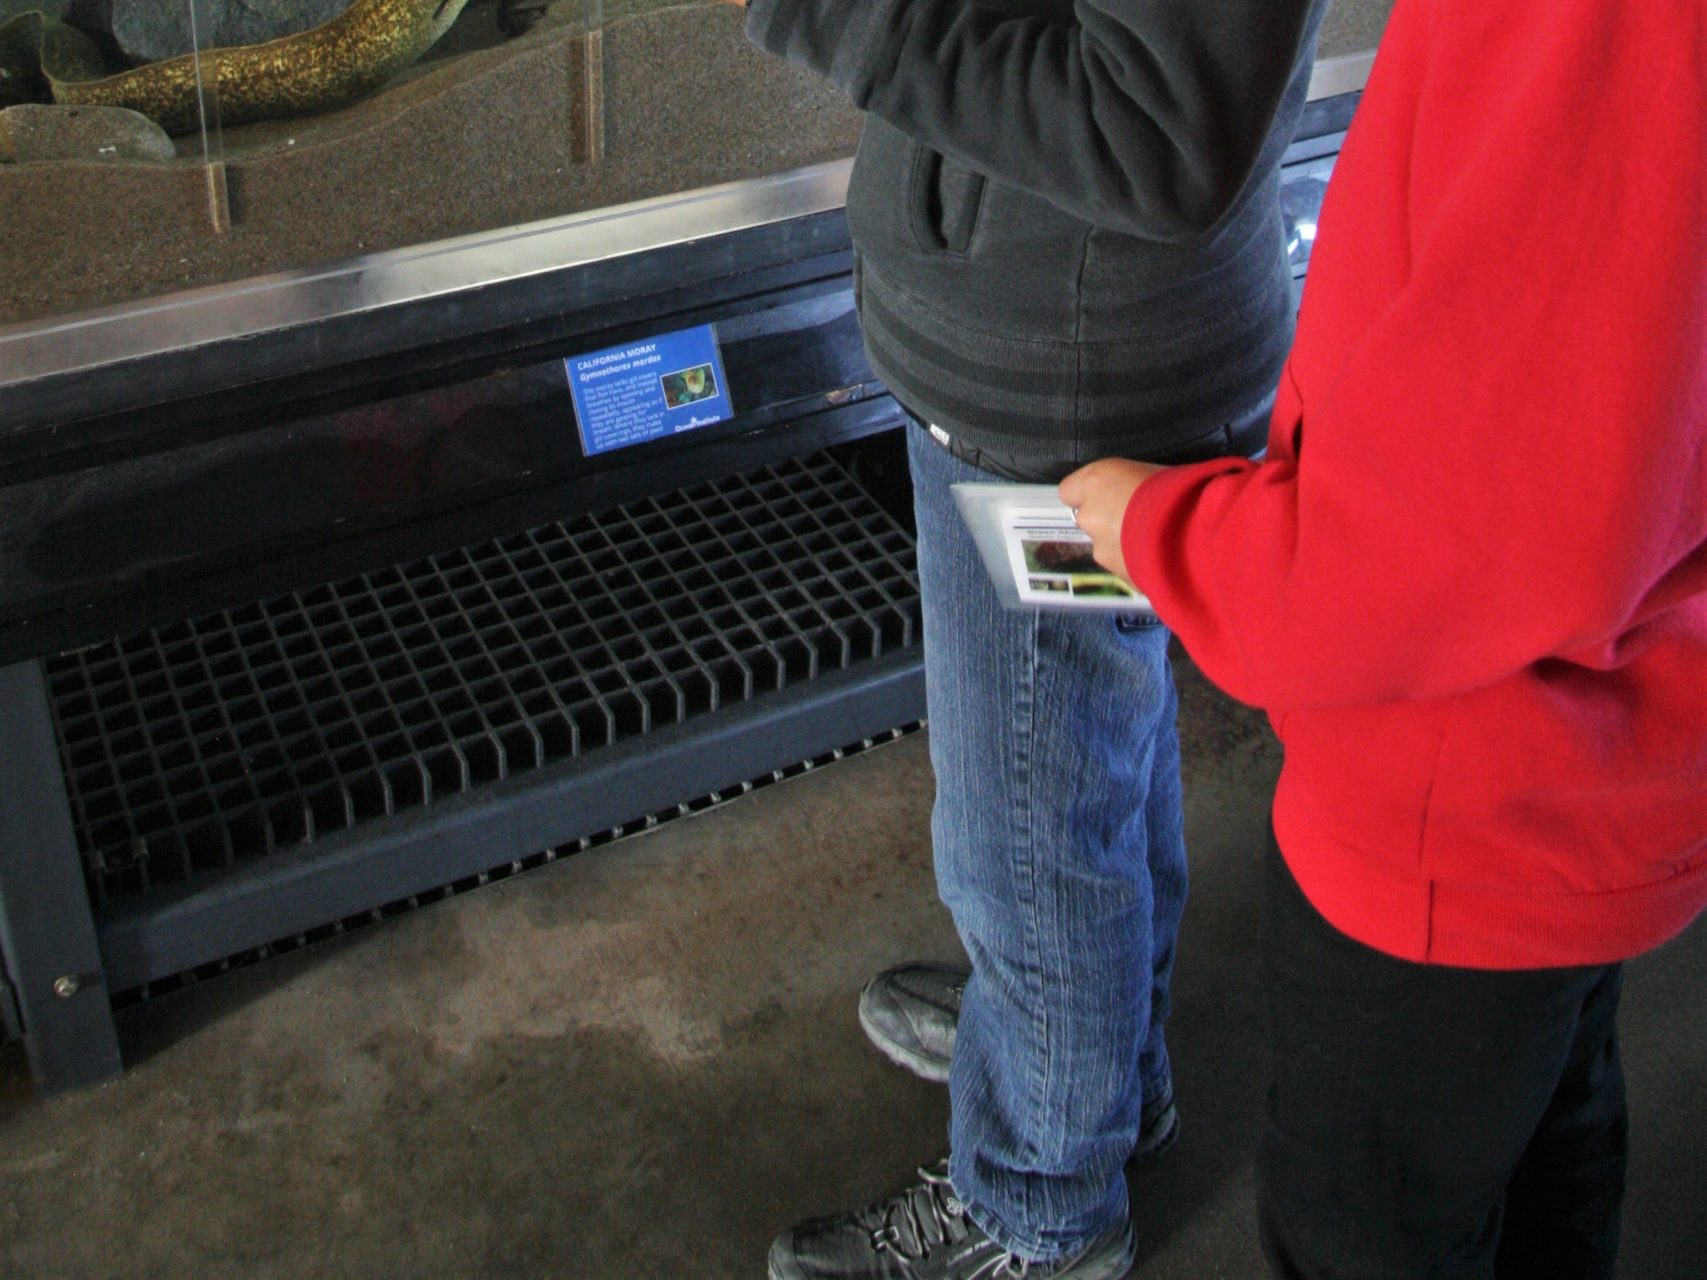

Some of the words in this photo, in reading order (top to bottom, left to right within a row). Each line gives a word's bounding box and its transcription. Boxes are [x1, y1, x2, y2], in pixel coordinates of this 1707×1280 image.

[578, 351, 626, 371] CALIFORNIA
[627, 344, 656, 358] MORAY
[580, 363, 631, 382] Gymnothorax
[633, 354, 661, 367] mordax
